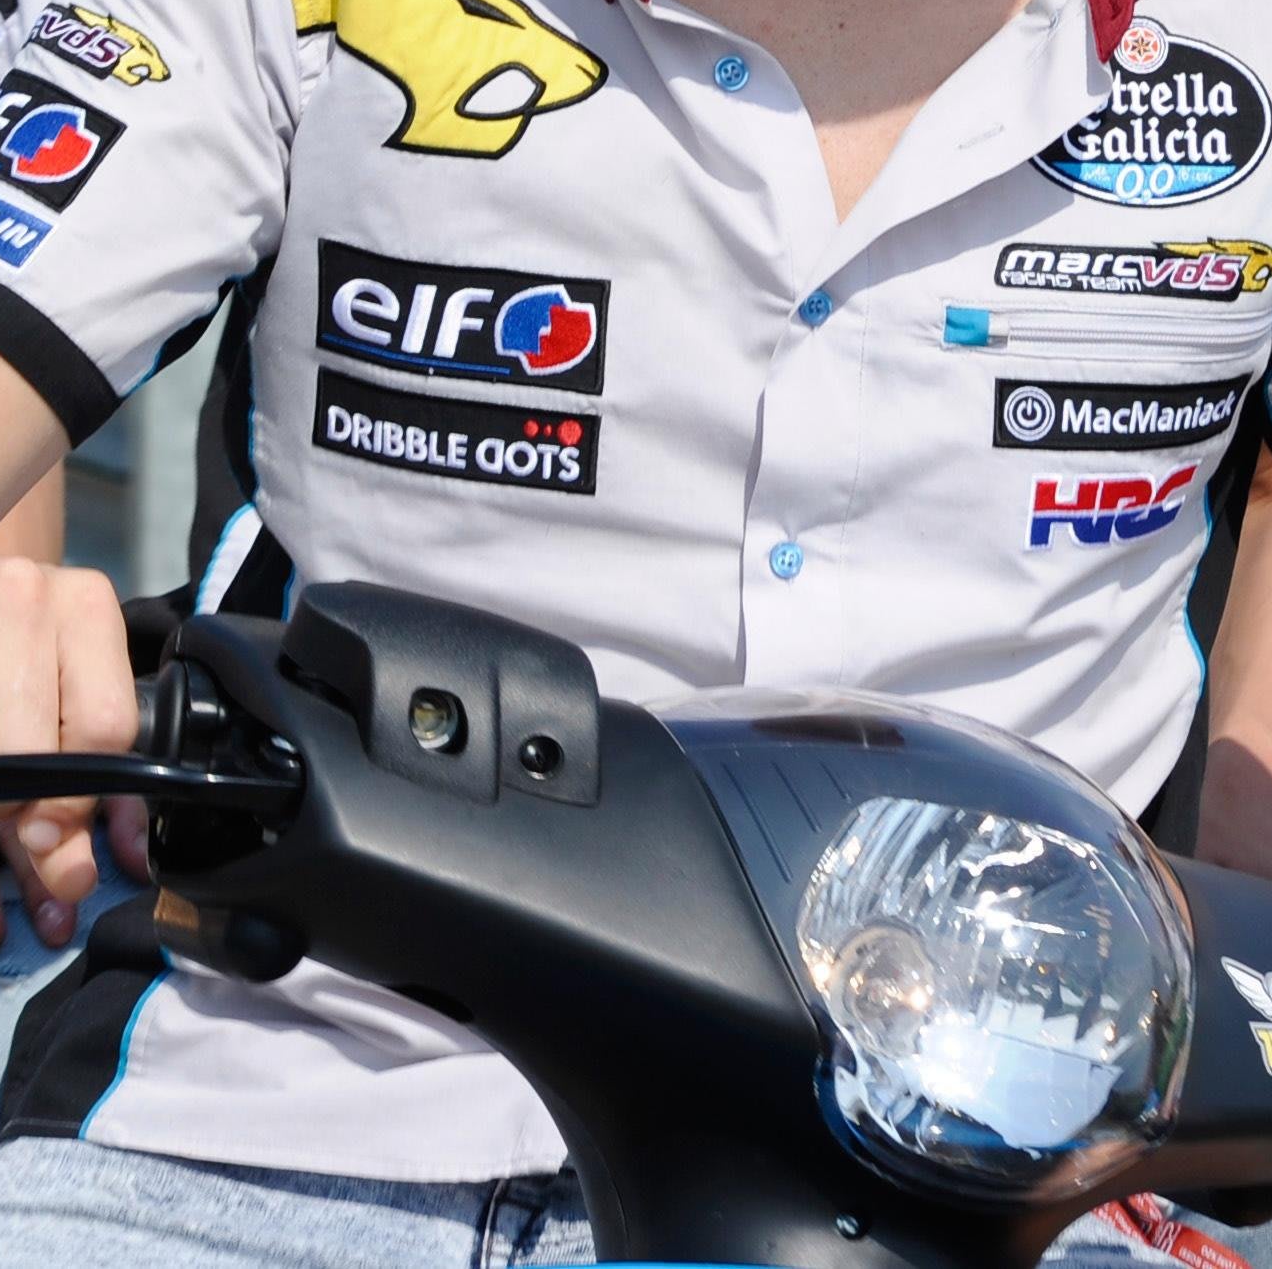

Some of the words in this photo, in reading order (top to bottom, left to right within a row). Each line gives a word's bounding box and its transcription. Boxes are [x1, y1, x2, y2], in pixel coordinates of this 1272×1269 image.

[1110, 71, 1238, 117] trella
[327, 405, 468, 470] DRIBBLE
[1061, 390, 1236, 435] MacManiack
[1024, 458, 1202, 552] HRC
